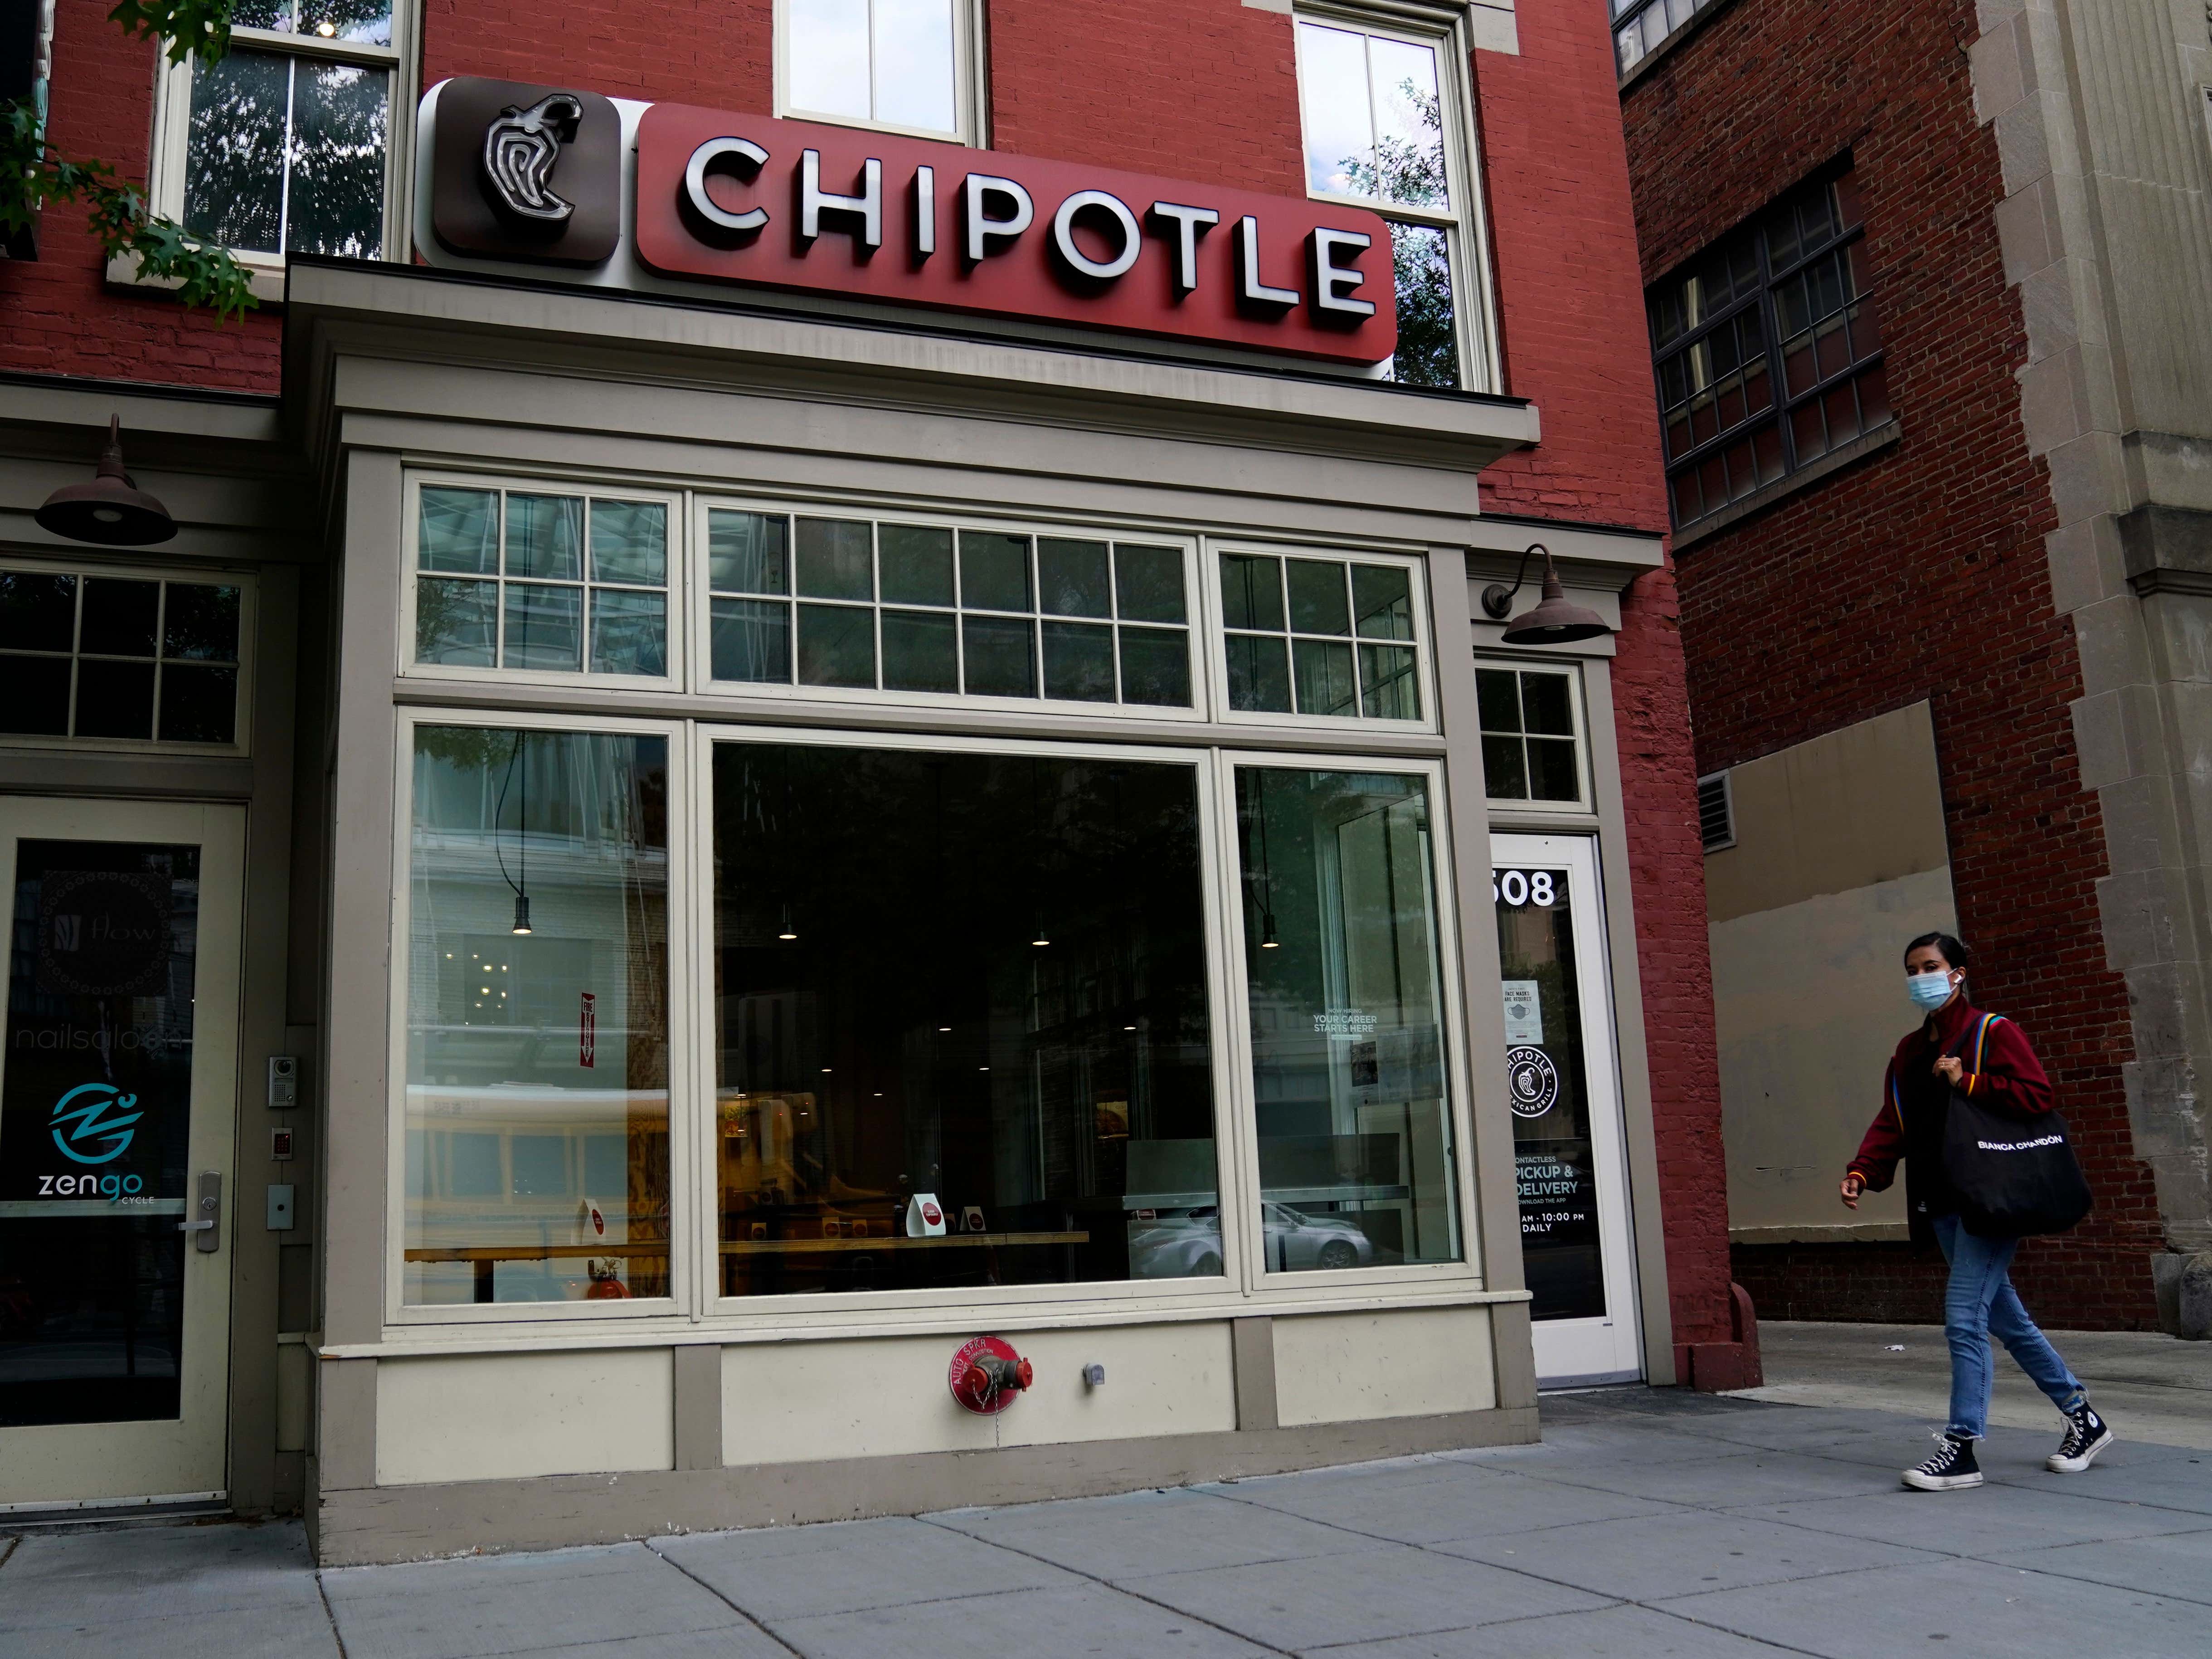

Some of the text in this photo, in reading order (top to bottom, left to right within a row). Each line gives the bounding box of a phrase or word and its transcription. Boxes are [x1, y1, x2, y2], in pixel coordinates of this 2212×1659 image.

[684, 135, 1377, 323] CHIPOTLE
[91, 910, 156, 941] flow
[583, 1001, 593, 1012] FIRE
[1313, 1015, 1378, 1024] YOUR CAREER
[1314, 1024, 1374, 1032] STARTS HERE
[1507, 1051, 1552, 1076] HIPOTLE
[1536, 1088, 1552, 1109] GRILL
[1977, 1140, 2016, 1151] BIANCA
[1564, 1165, 1574, 1177] &
[38, 1174, 143, 1202] zengo
[122, 1197, 155, 1205] CYCLE
[1542, 1212, 1570, 1221] 10:00
[1522, 1223, 1551, 1232] DAILY
[953, 1338, 986, 1384] AUTO SPKR
